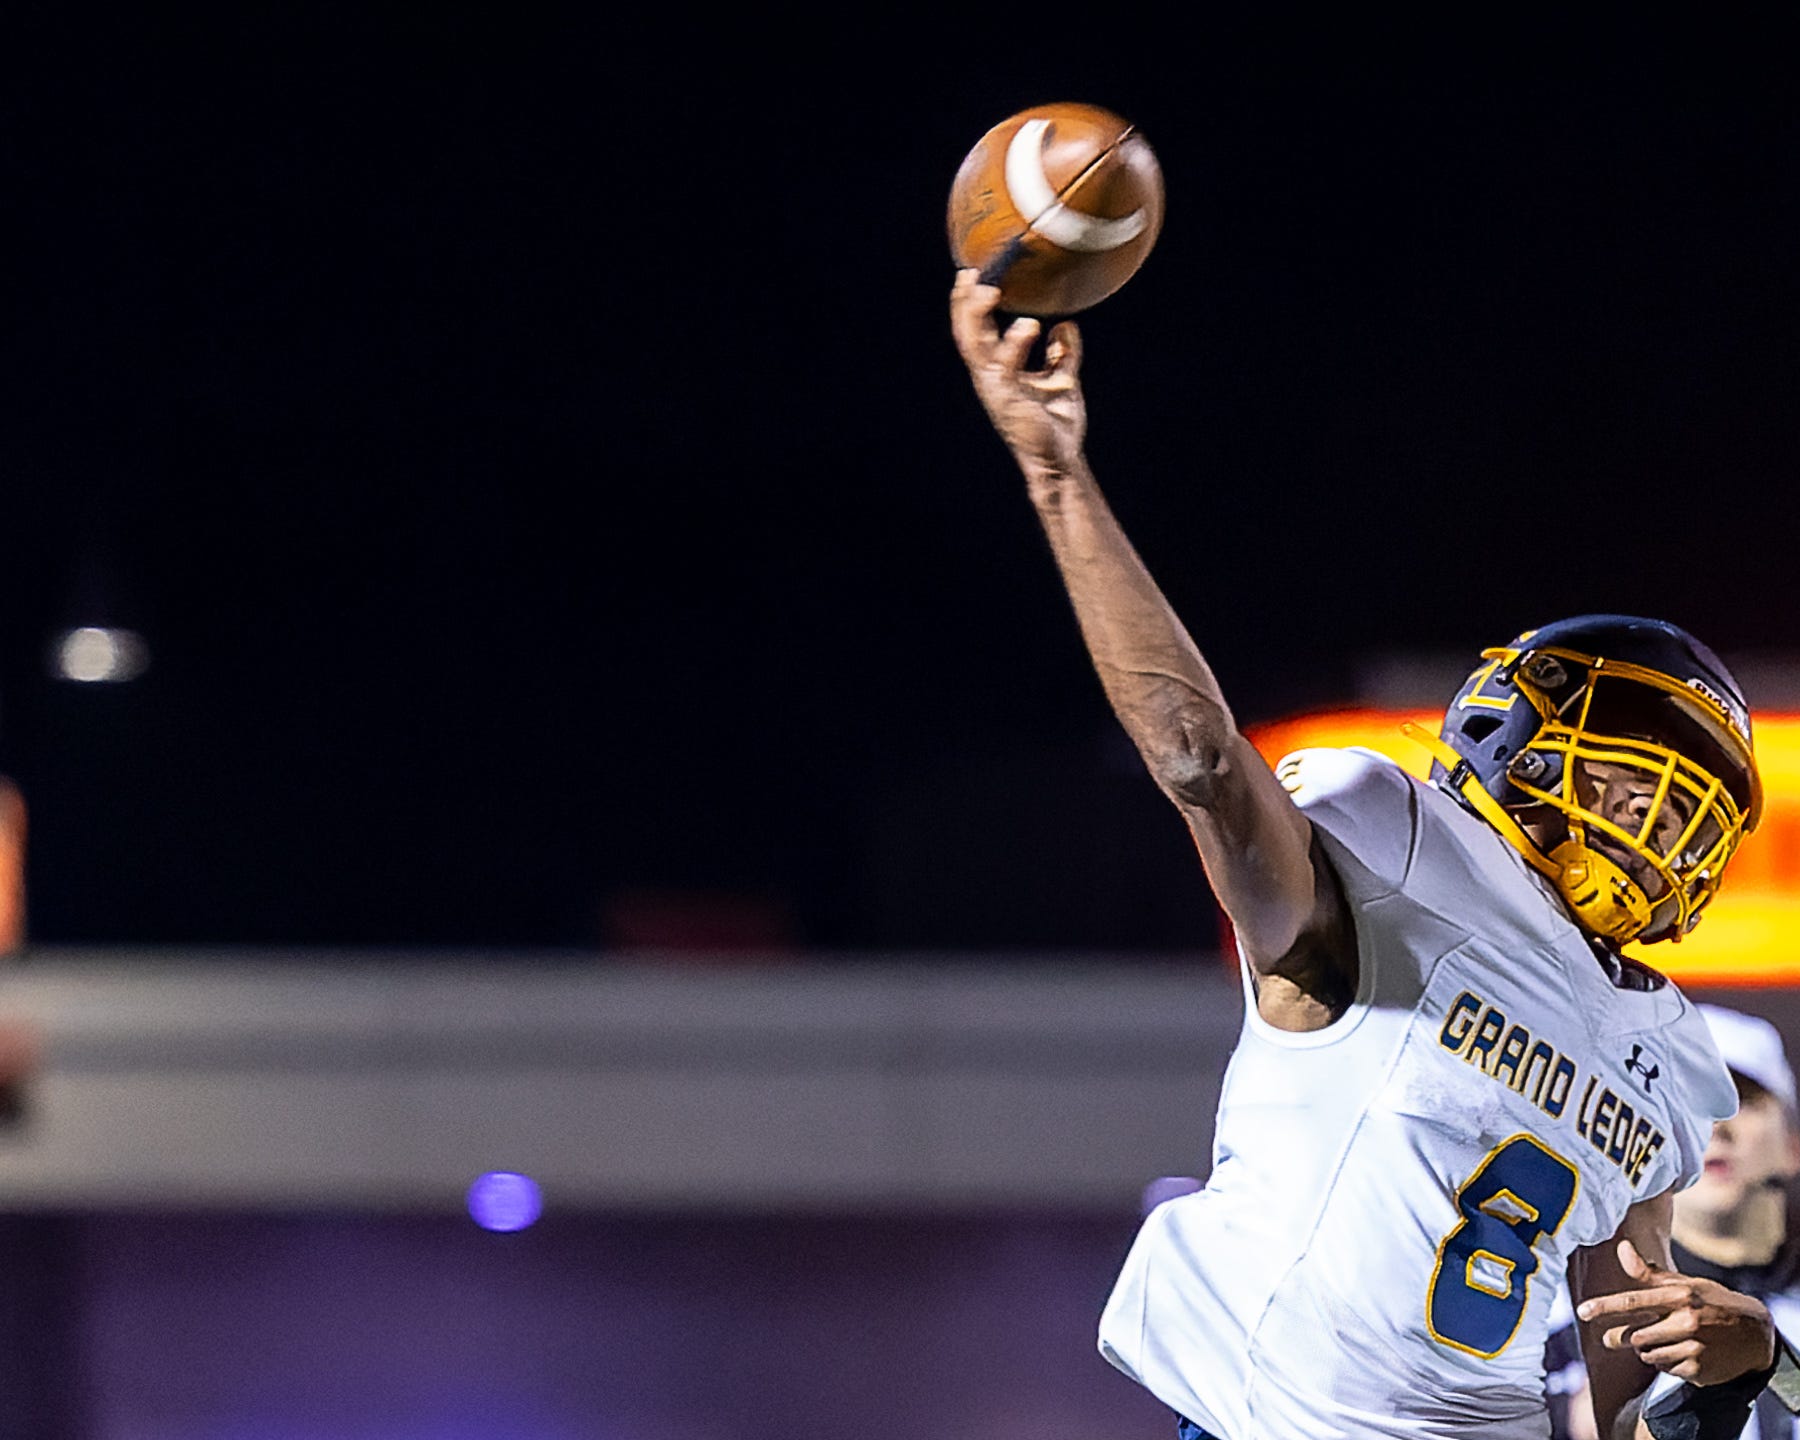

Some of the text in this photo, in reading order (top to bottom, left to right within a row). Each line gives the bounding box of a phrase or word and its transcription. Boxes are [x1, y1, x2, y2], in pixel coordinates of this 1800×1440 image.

[1437, 989, 1666, 1190] GRAND LEDGE
[1426, 1132, 1581, 1360] 8
